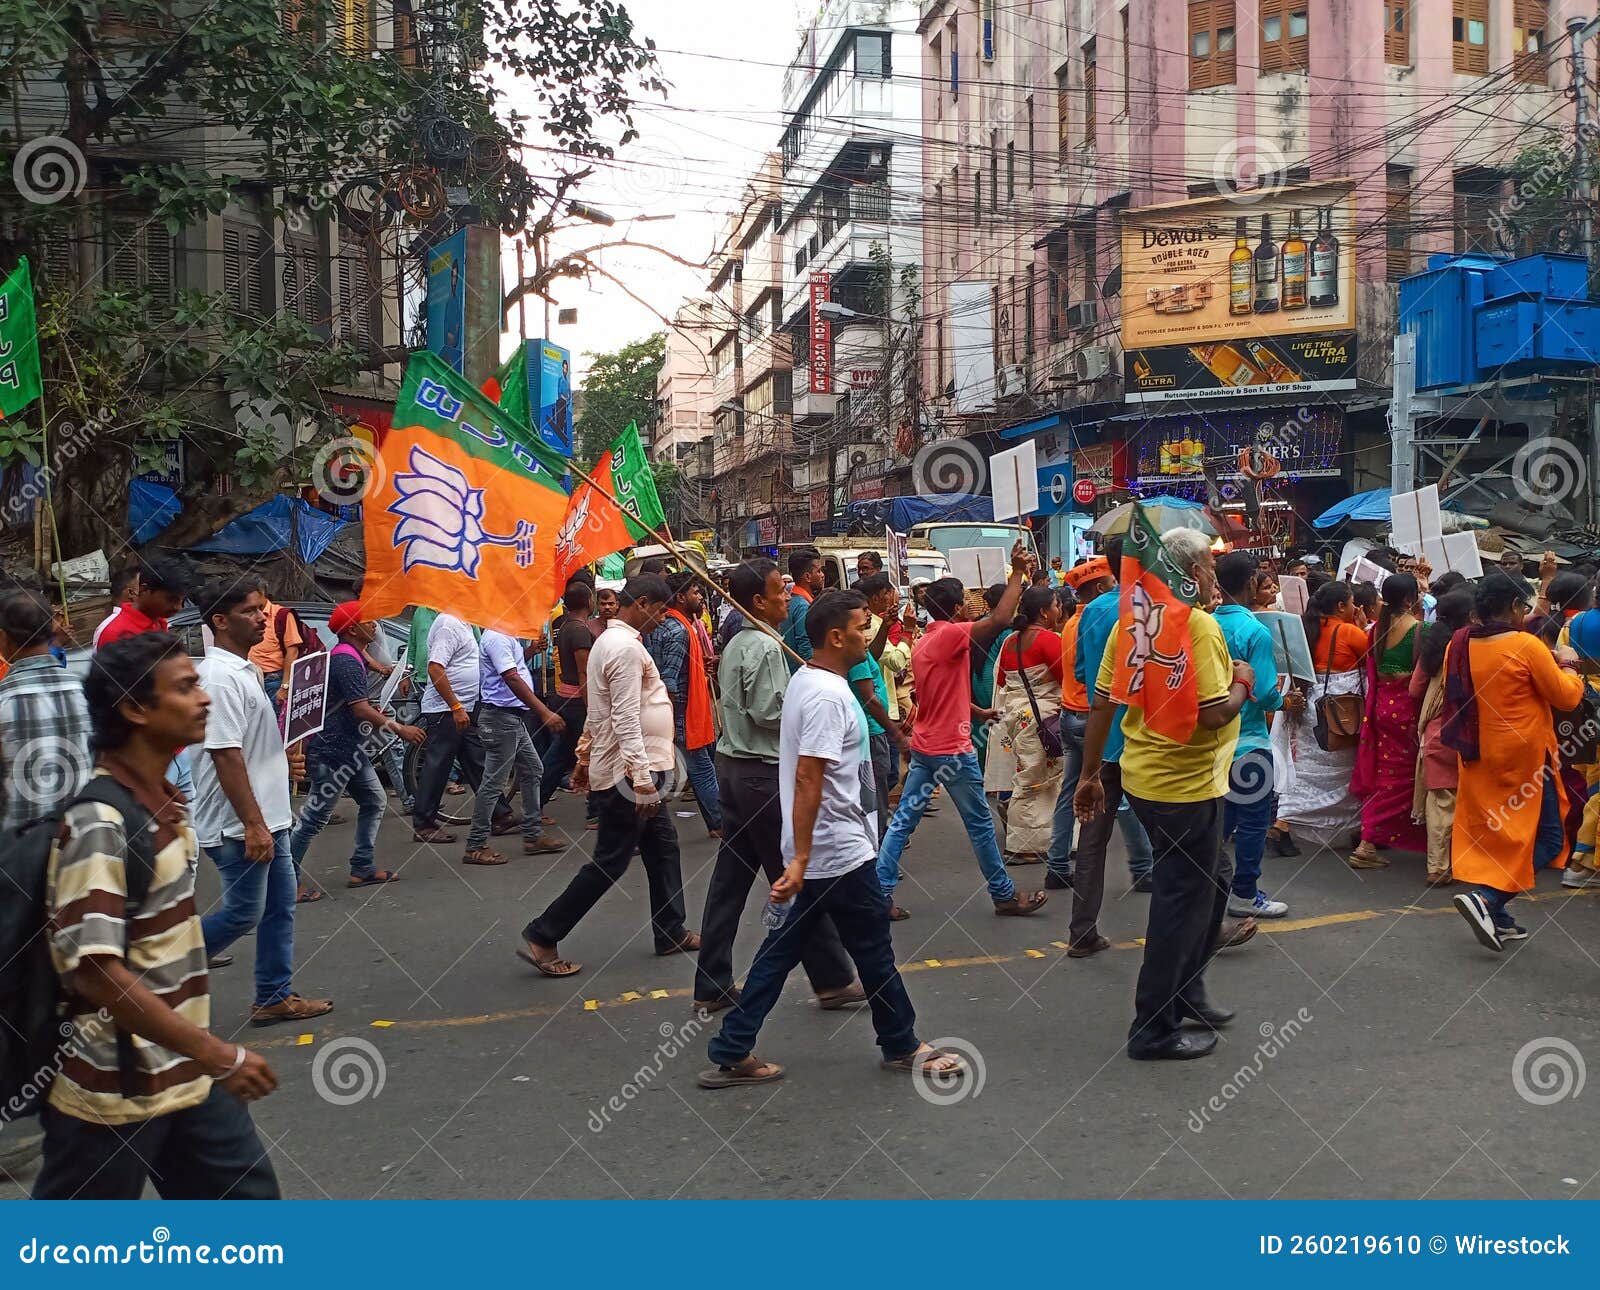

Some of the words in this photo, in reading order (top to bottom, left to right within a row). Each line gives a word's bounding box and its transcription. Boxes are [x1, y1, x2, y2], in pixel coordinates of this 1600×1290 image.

[1151, 249, 1183, 264] DOUBLE
[1186, 248, 1209, 258] AGED
[1291, 342, 1312, 350] LIVE
[1304, 347, 1346, 358] ULTRA
[1325, 355, 1348, 364] LIFE
[1141, 377, 1173, 386] ULTRA
[1164, 391, 1197, 399] Ruttonjee
[1199, 388, 1234, 397] Dadabhoy
[1292, 384, 1312, 392] Shop
